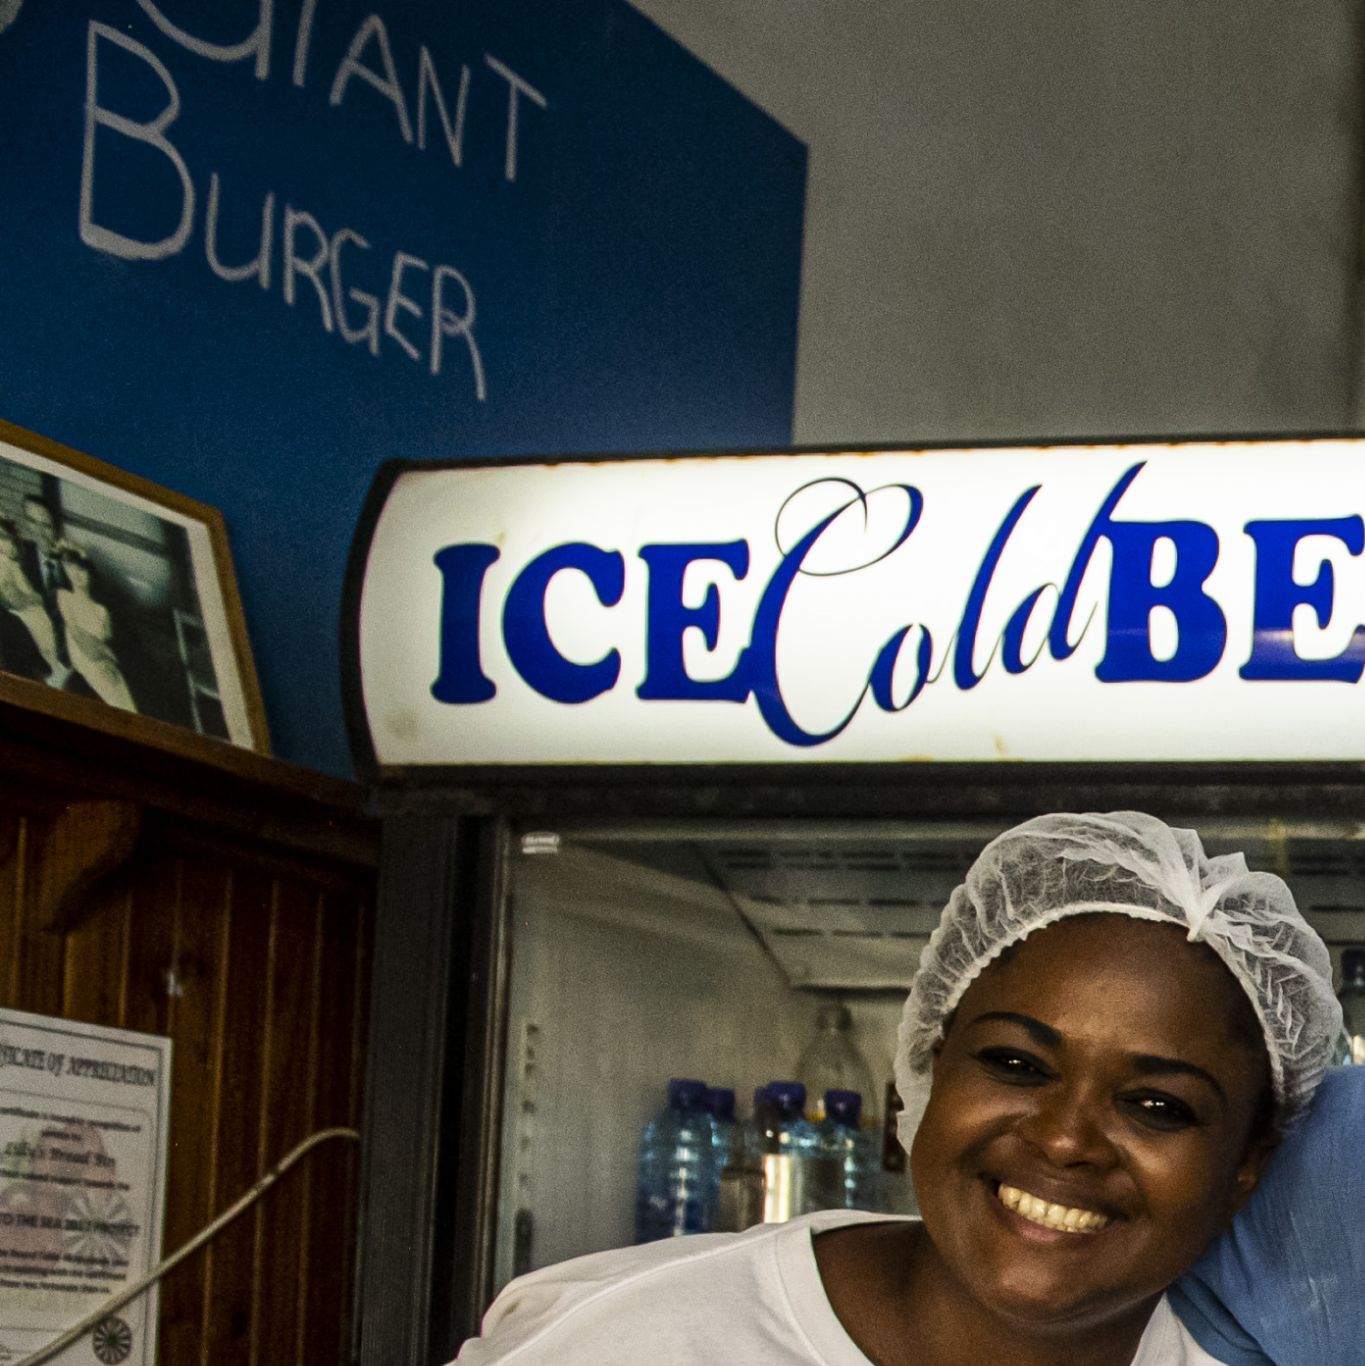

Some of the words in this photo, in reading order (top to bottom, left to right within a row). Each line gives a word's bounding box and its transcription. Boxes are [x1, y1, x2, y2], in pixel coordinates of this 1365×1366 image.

[80, 20, 486, 401] BURGER
[431, 539, 752, 704] ICE
[748, 461, 1148, 747] Cold
